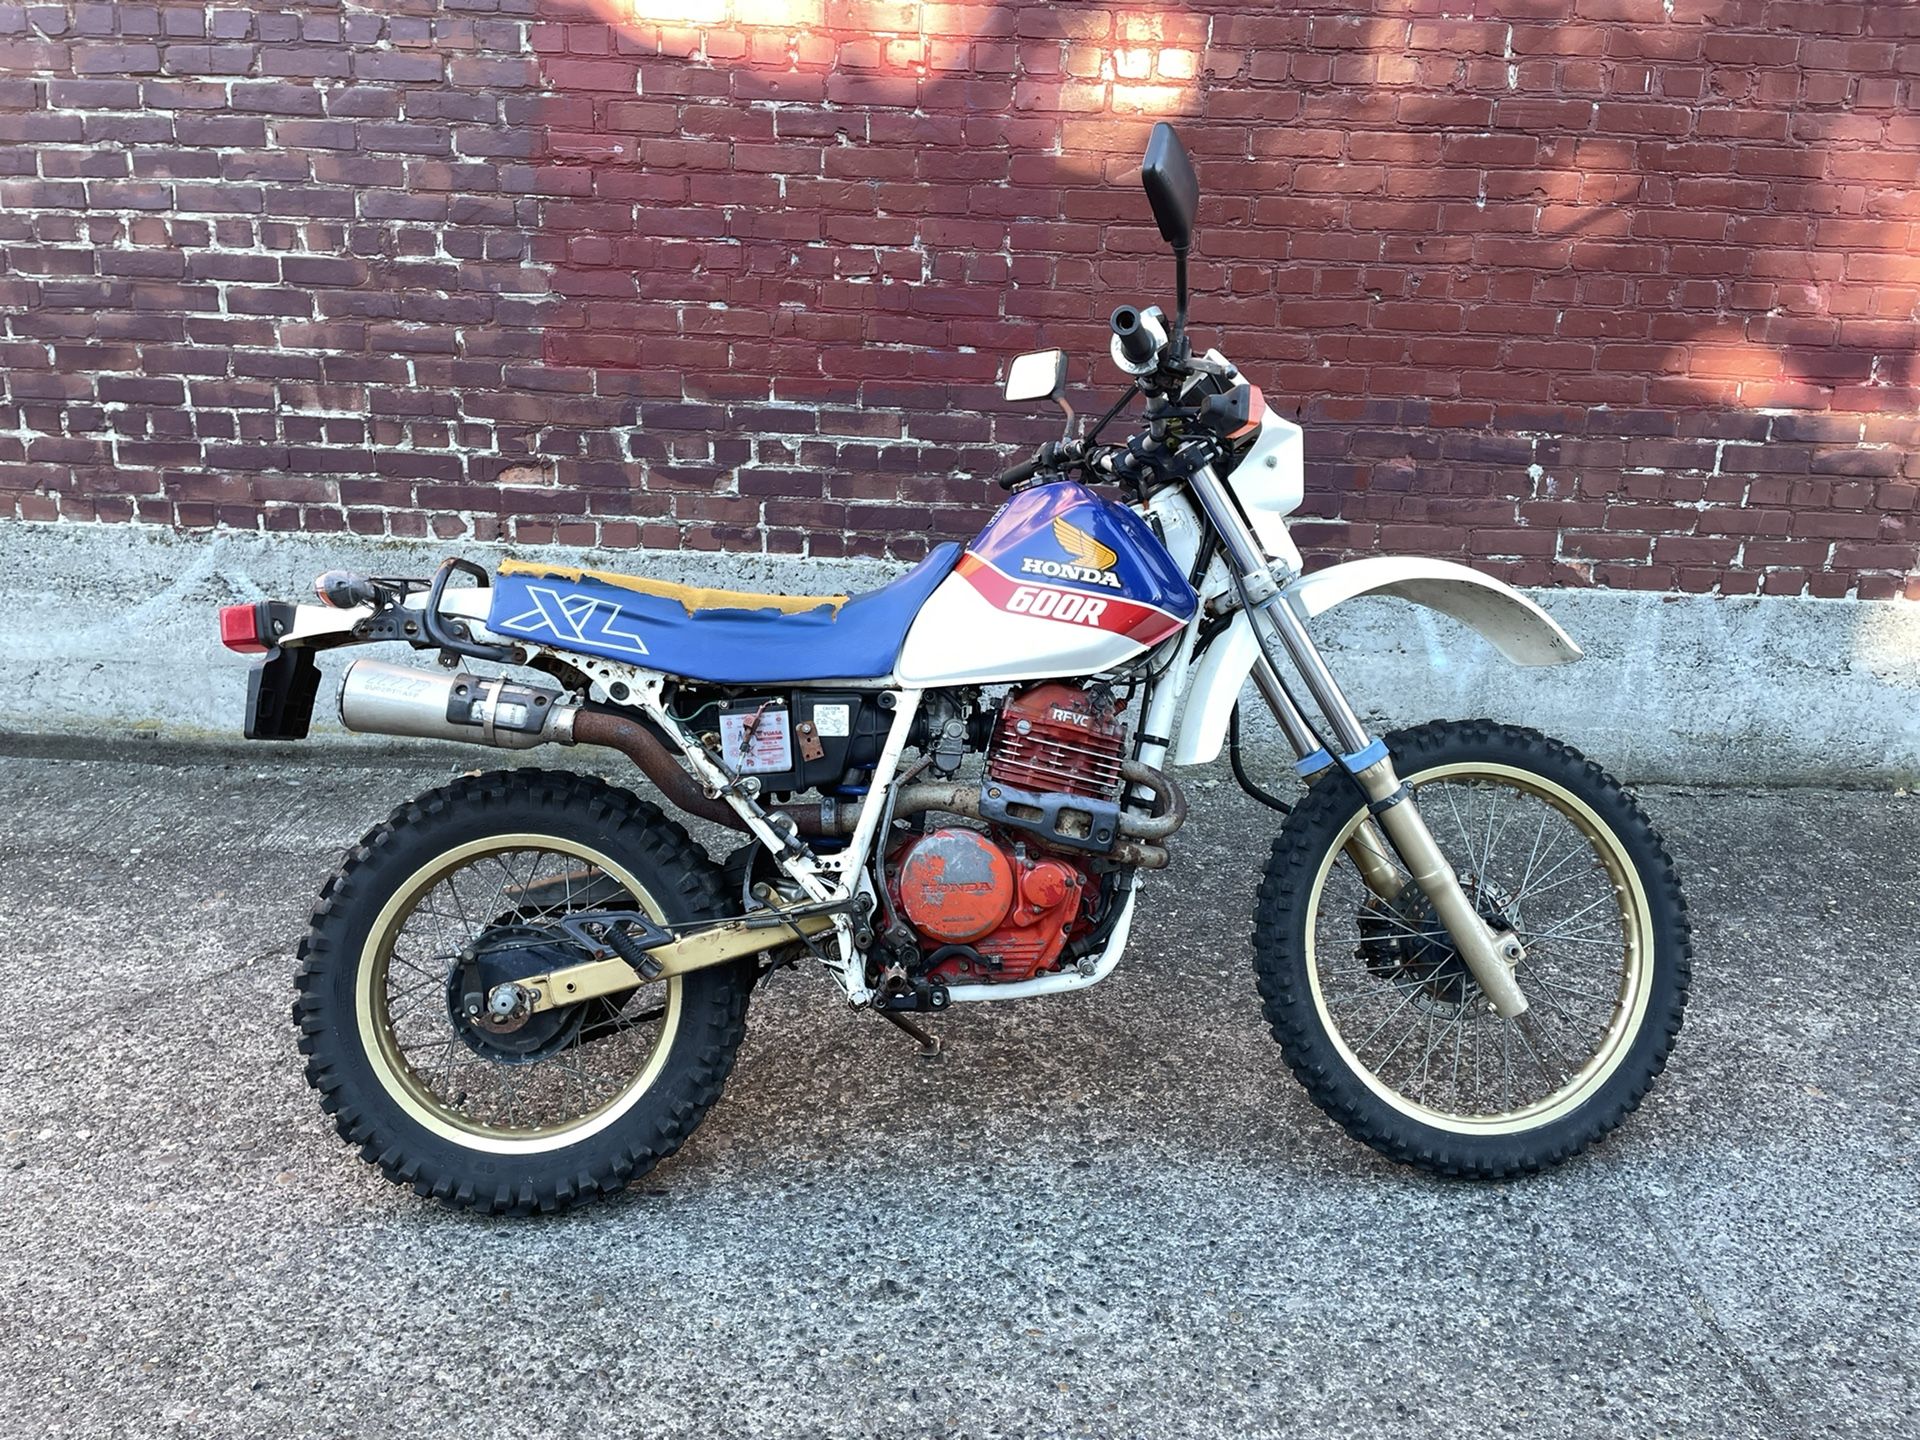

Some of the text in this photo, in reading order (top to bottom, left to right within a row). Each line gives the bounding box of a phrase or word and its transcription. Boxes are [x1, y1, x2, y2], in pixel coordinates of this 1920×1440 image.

[1021, 558, 1121, 588] HONDA
[500, 584, 649, 655] XL
[1006, 585, 1108, 627] 600R
[922, 880, 992, 894] HONDA
